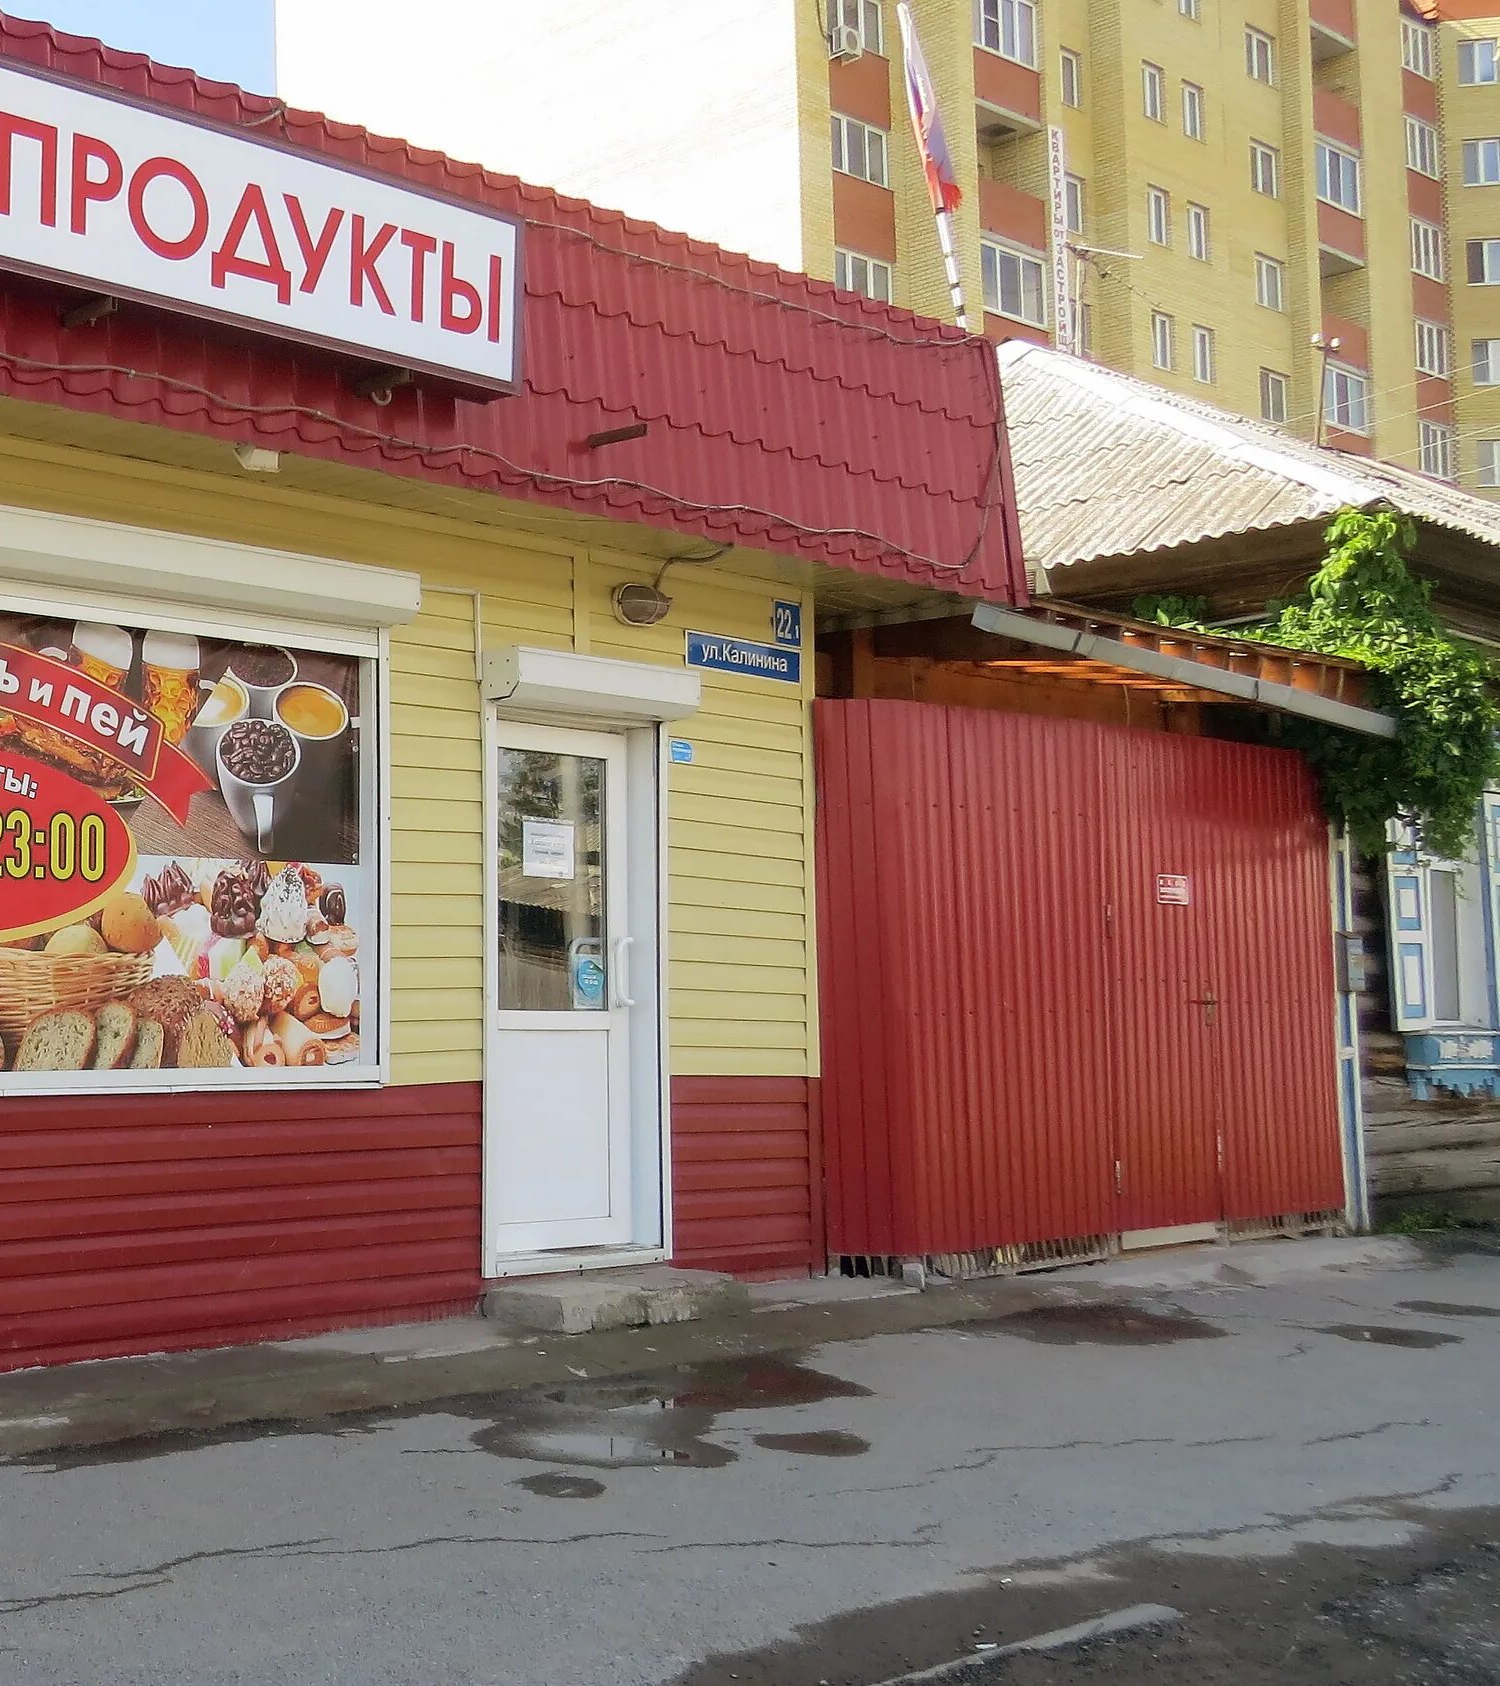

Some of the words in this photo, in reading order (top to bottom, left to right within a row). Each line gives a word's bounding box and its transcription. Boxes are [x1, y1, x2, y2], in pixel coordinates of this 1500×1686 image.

[1051, 129, 1064, 226] КВАРТИРЫ
[776, 607, 792, 640] 22
[701, 643, 788, 673] ул.Калинина
[28, 677, 54, 708] и
